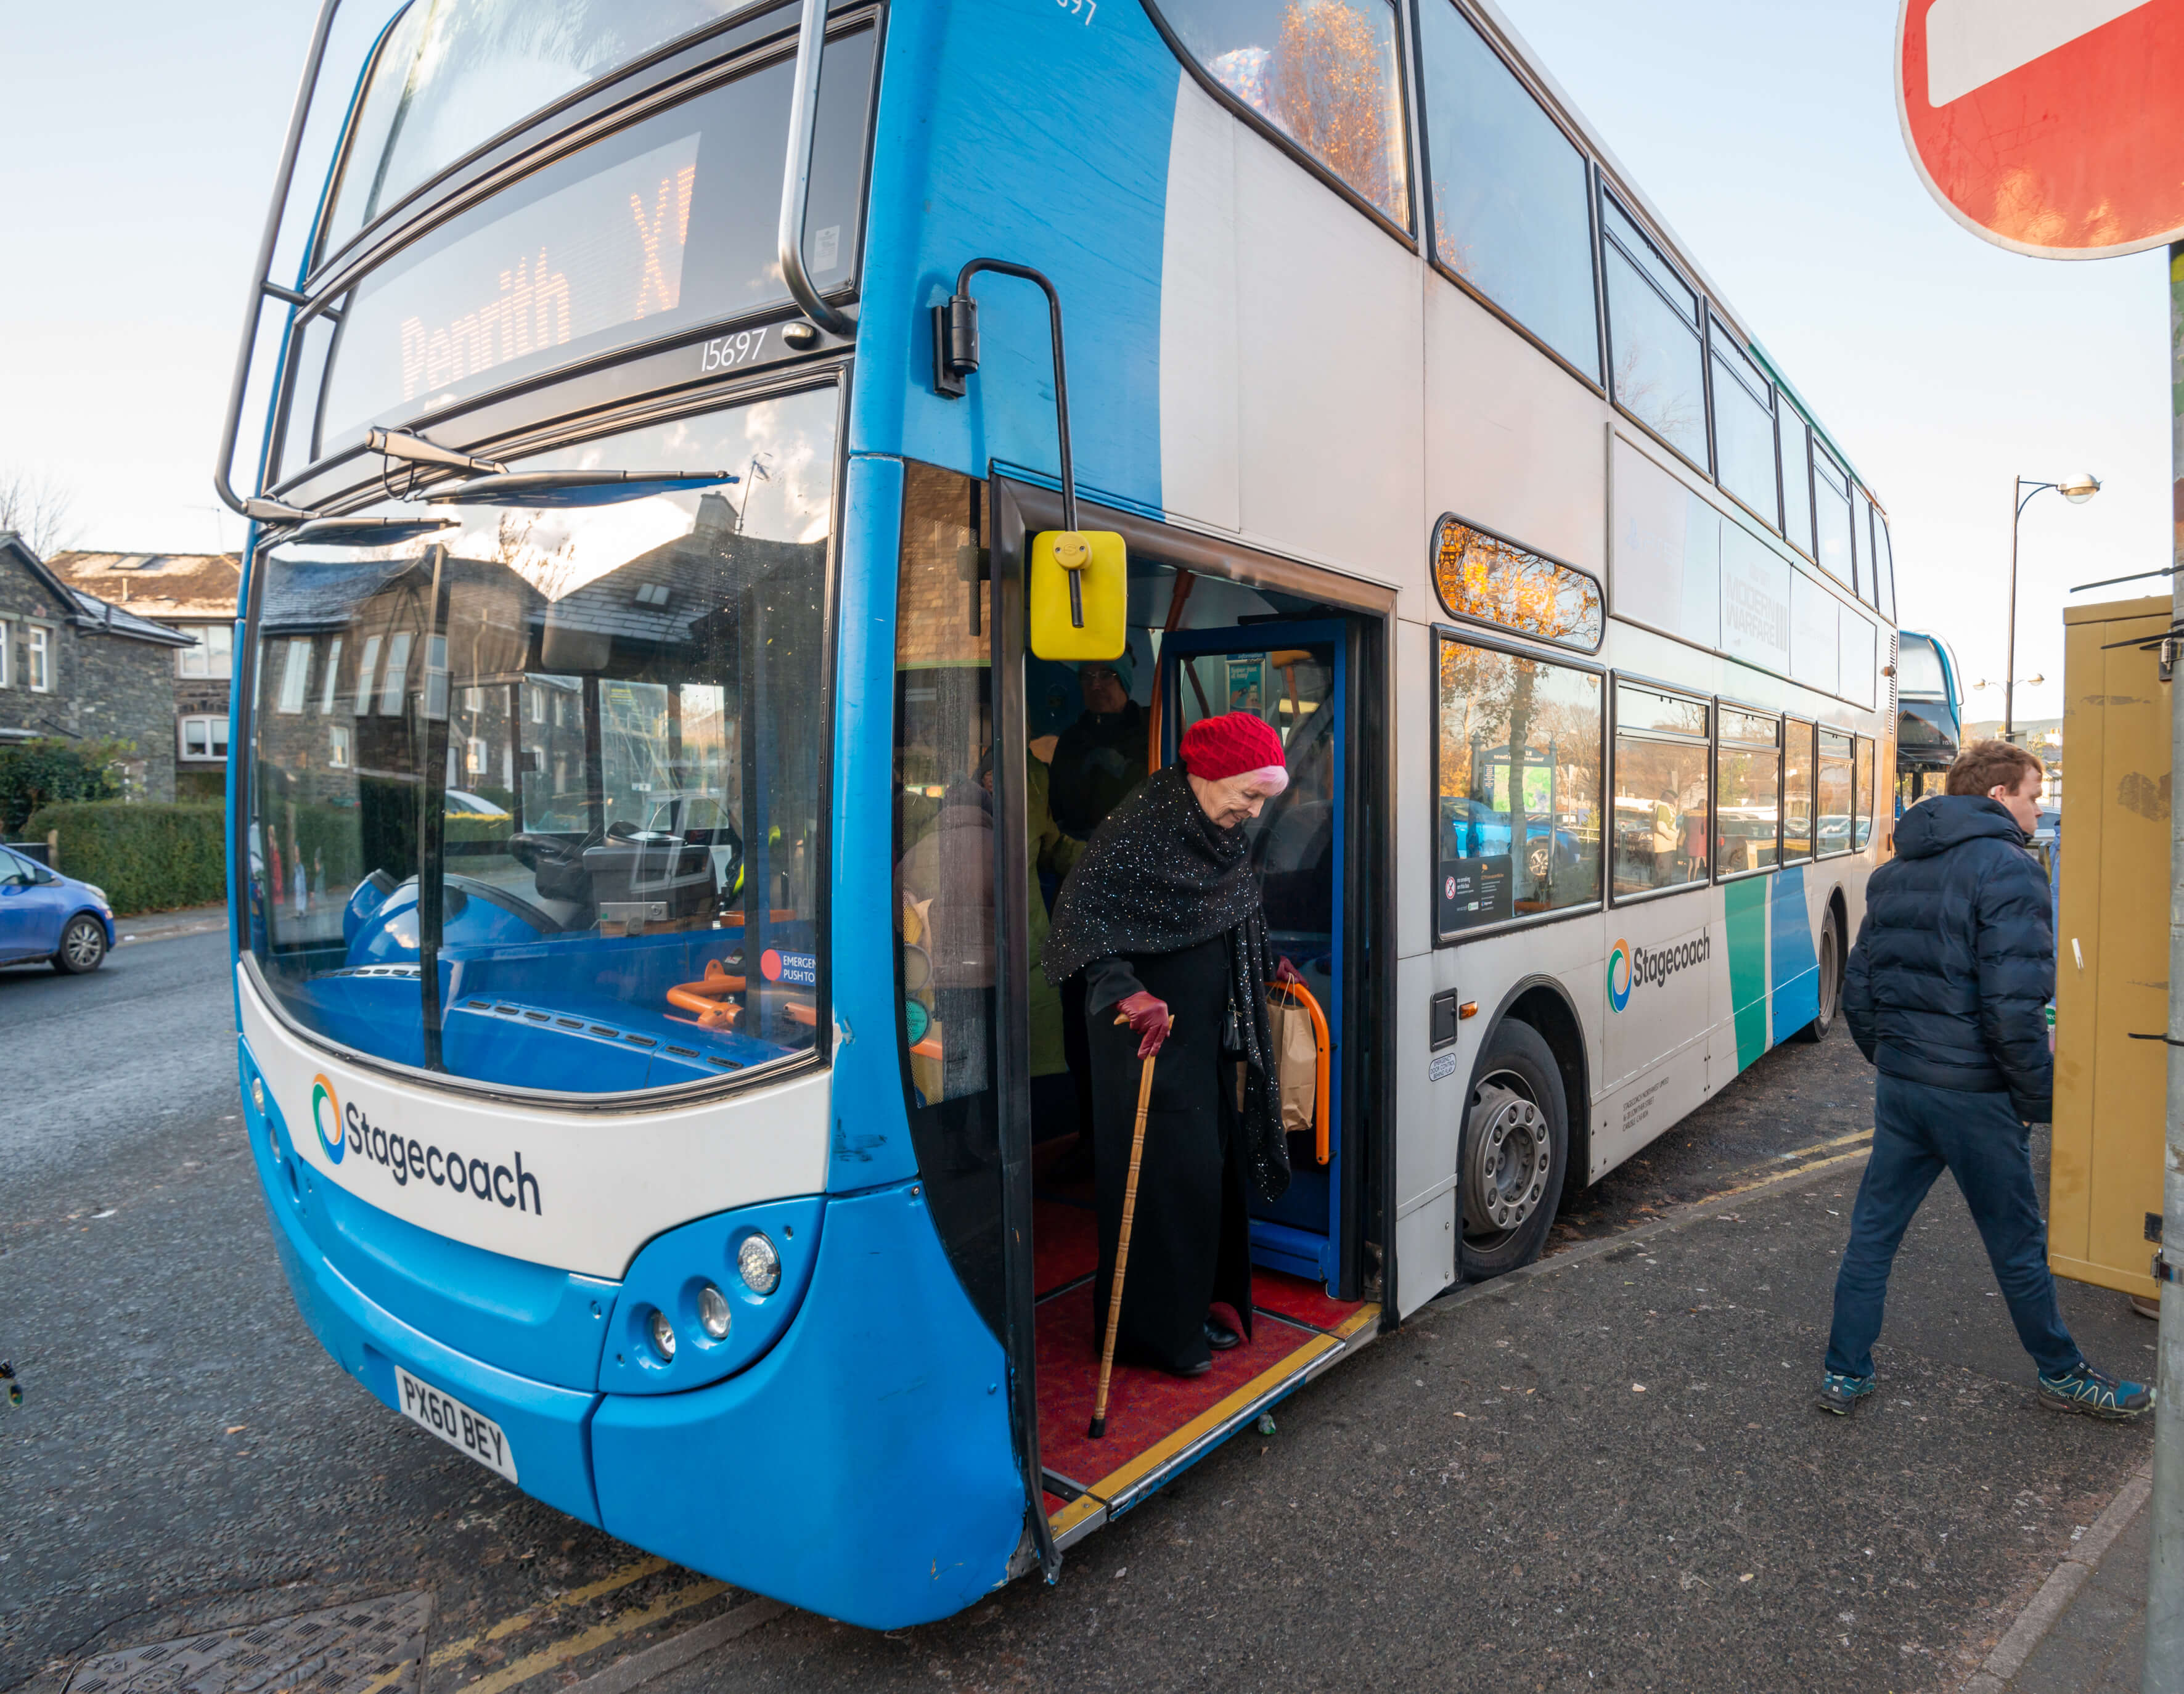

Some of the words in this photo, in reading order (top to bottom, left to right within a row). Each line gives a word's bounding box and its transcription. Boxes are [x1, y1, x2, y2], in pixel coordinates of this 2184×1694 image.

[401, 248, 571, 402] Penrith
[701, 327, 768, 372] 15697
[1726, 572, 1775, 620] MODERN
[1726, 602, 1775, 646] WARFARE
[783, 968, 803, 981] PUSH
[803, 971, 815, 983] TO
[1634, 925, 1710, 988] Stagecoach
[1430, 1066, 1440, 1074] DOOR
[1440, 1060, 1455, 1070] CONTROL
[346, 1102, 542, 1216] Stagecoach
[404, 1377, 457, 1438] PX60
[464, 1410, 503, 1467] BEY
